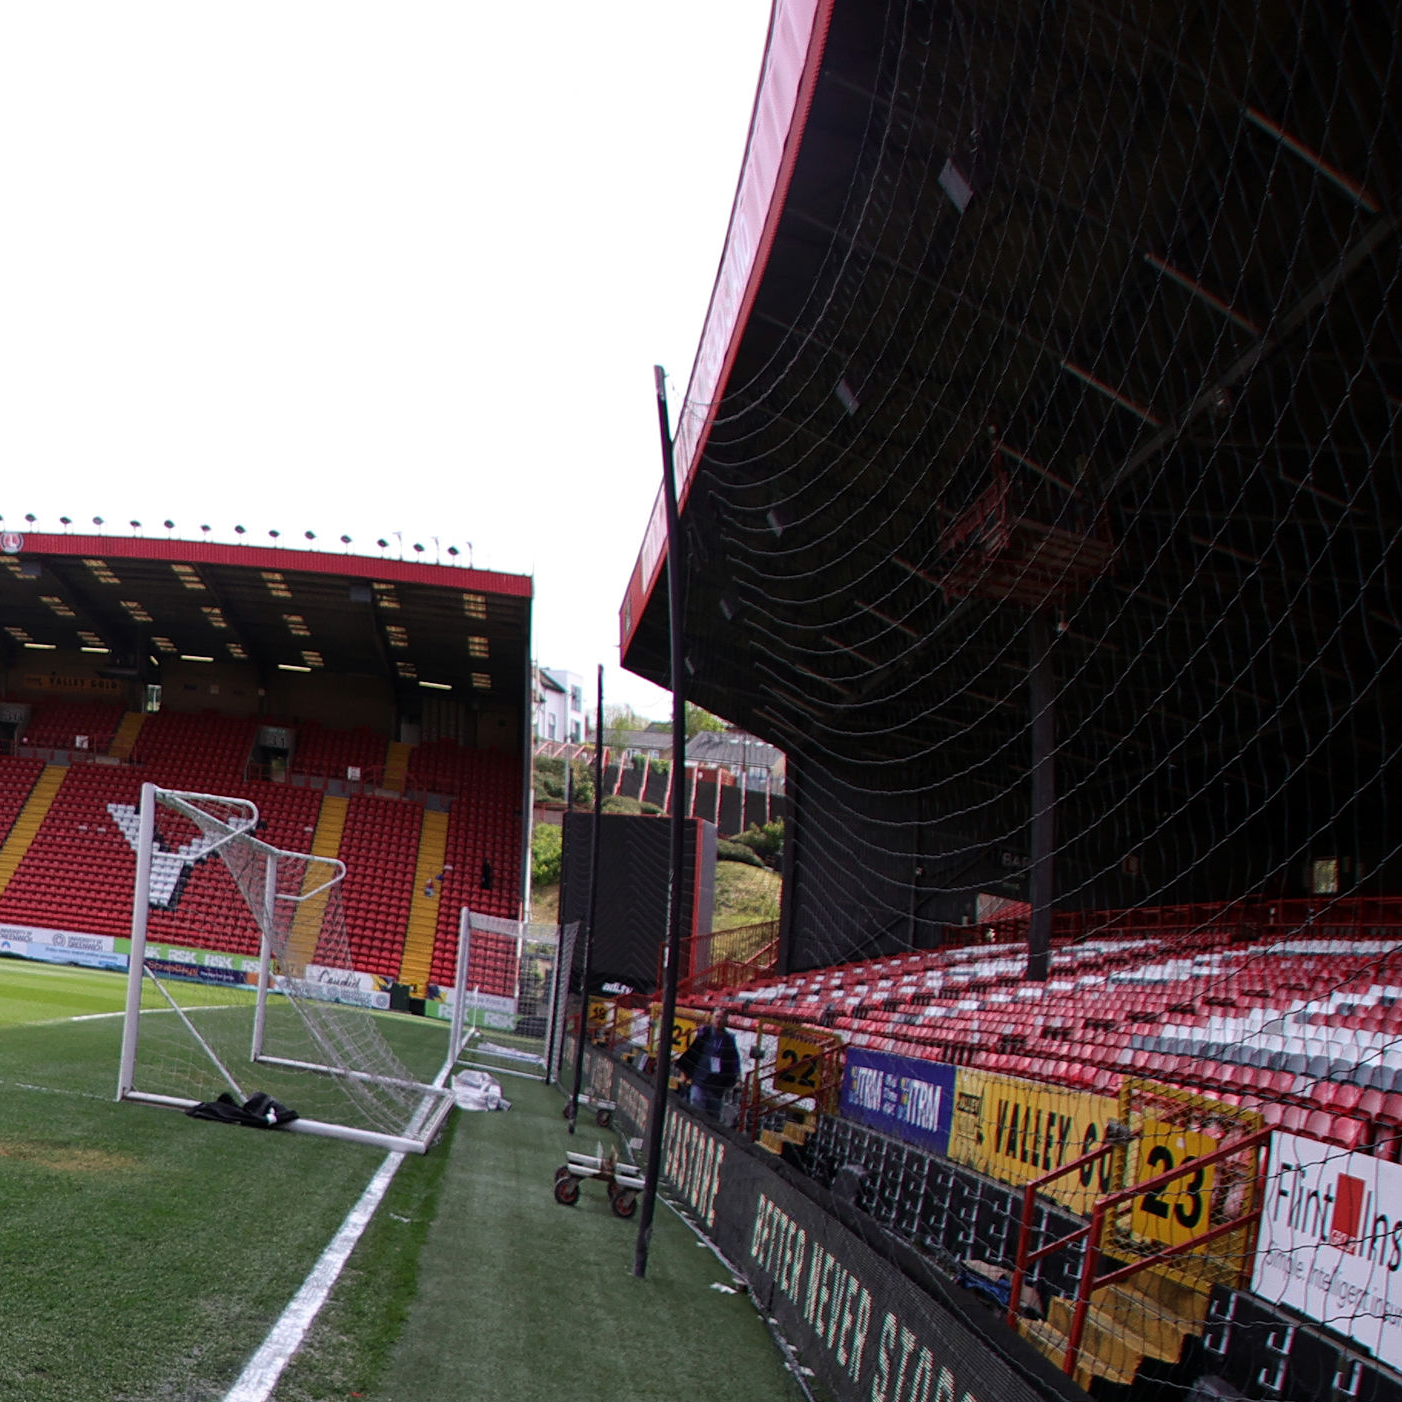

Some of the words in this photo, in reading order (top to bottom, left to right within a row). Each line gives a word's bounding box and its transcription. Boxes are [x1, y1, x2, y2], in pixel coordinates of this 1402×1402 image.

[145, 945, 161, 959] SK
[168, 949, 197, 964] RSK
[205, 953, 234, 970] RSK
[484, 1012, 516, 1030] RSK
[779, 1048, 817, 1089] 22
[856, 1066, 884, 1112] ITRM
[905, 1078, 942, 1133] ITRM
[662, 1104, 725, 1229] ASTORE
[995, 1098, 1072, 1172] VALLEY
[1080, 1121, 1112, 1195] GO
[1140, 1144, 1206, 1229] 23
[1272, 1161, 1335, 1242] Flint
[749, 1192, 807, 1307] BETTER
[803, 1240, 873, 1385] NEVER
